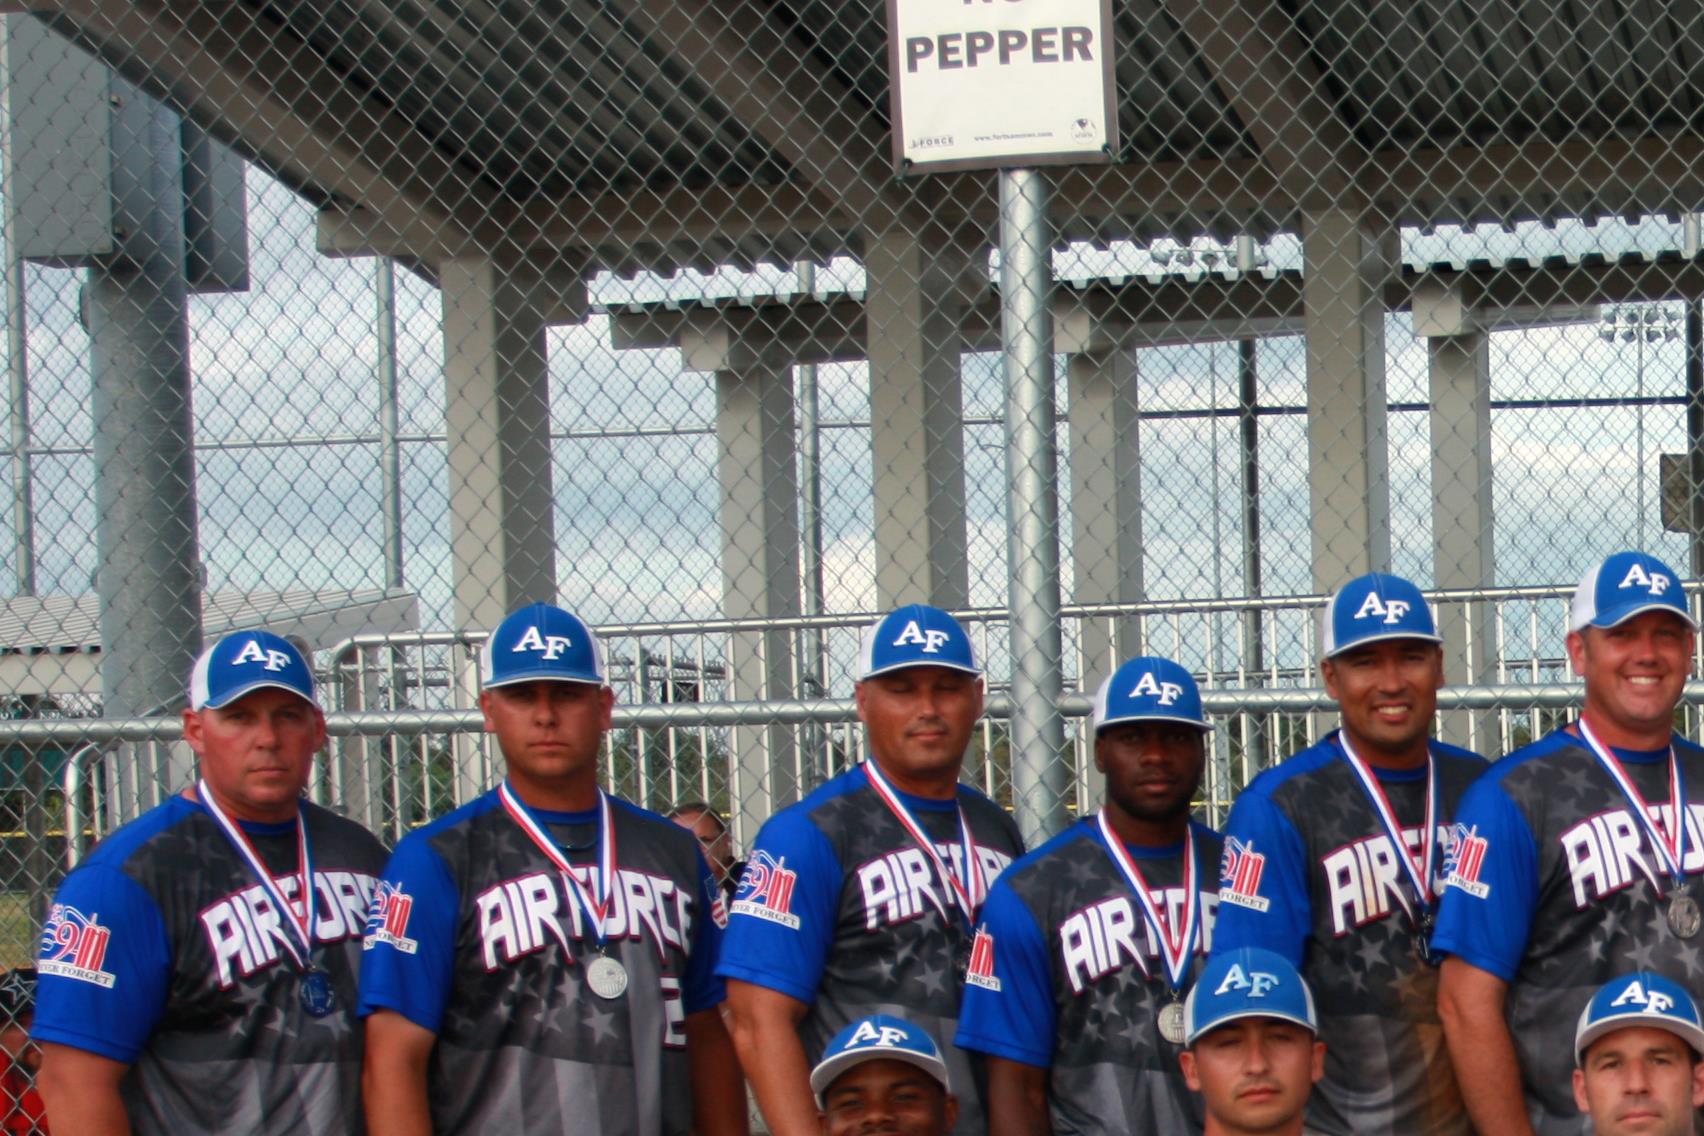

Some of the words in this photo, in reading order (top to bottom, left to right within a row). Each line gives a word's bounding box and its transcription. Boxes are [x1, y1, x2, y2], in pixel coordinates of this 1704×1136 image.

[906, 26, 1094, 72] PEPPER
[1618, 564, 1670, 596] AF
[1354, 591, 1410, 624] AF
[512, 626, 571, 660] AF
[893, 620, 949, 653] AF
[232, 640, 291, 672] AF
[1129, 672, 1183, 706] AF
[1560, 806, 1662, 910] AIR
[856, 848, 948, 932] AIR
[1321, 833, 1414, 937] AIR
[476, 871, 573, 972] AIR
[1060, 895, 1152, 996] AIR
[1215, 964, 1281, 997] AF
[1611, 980, 1675, 1015] AF
[844, 1021, 909, 1048] AF
